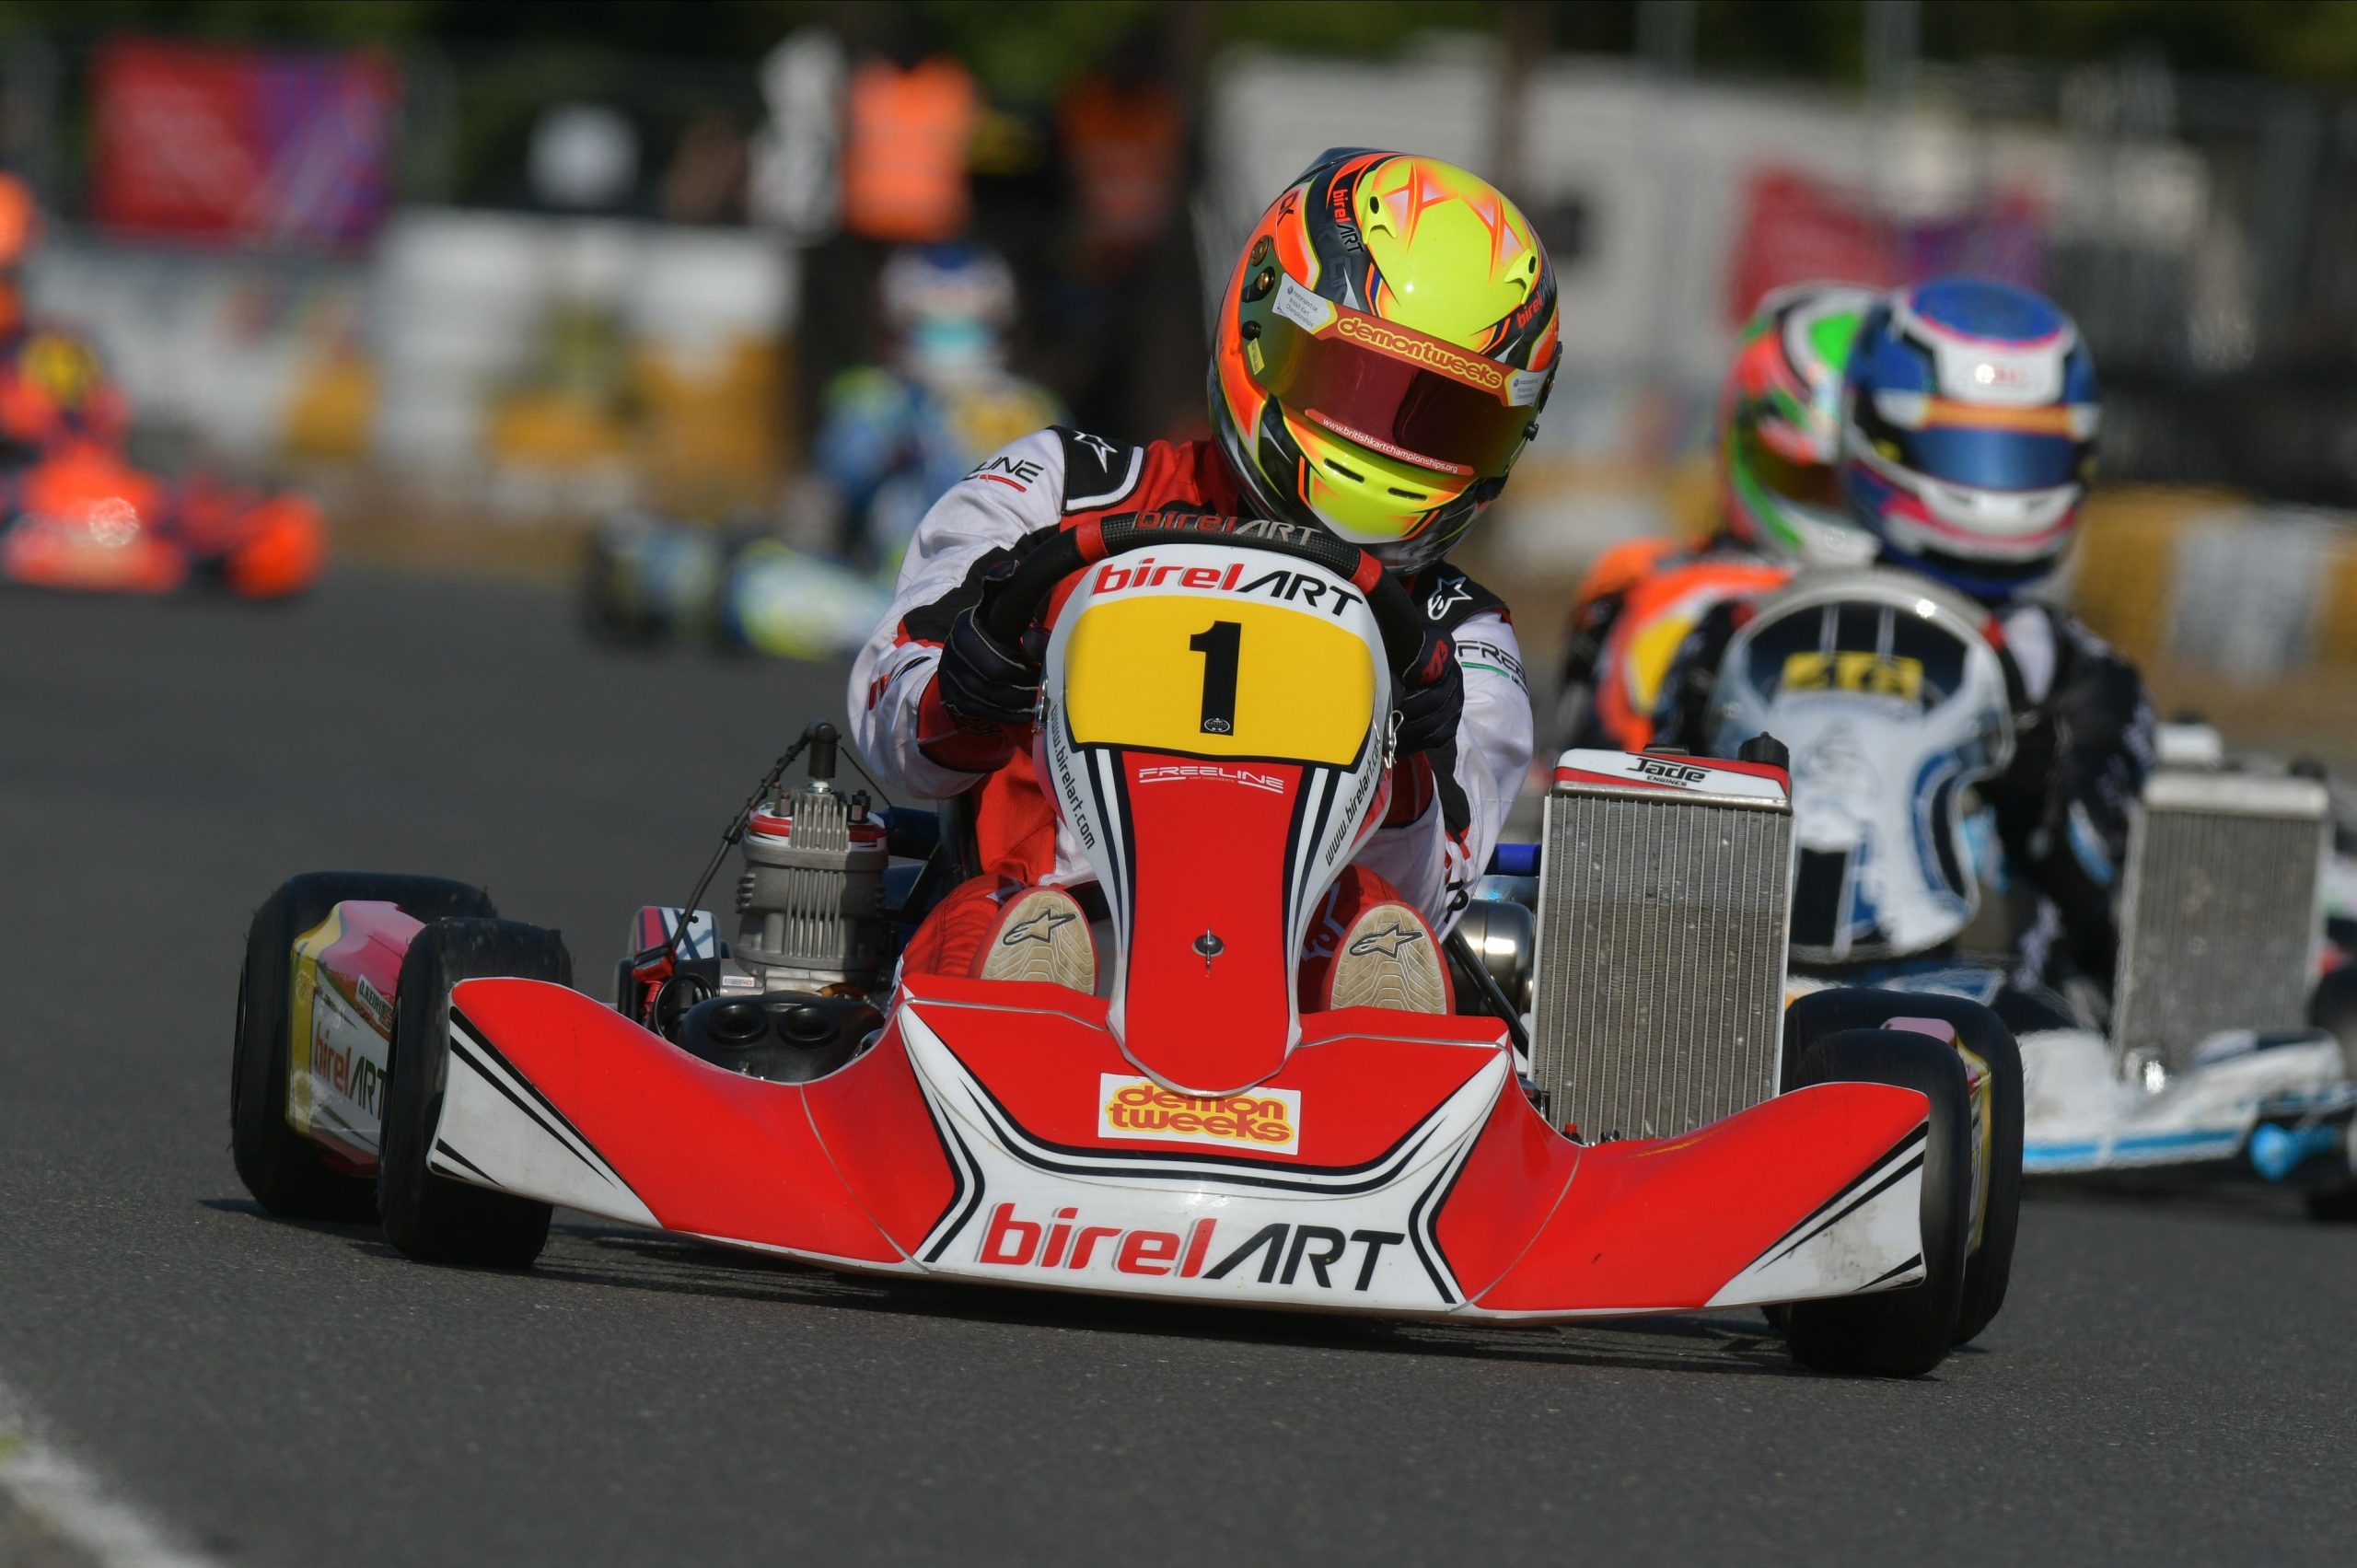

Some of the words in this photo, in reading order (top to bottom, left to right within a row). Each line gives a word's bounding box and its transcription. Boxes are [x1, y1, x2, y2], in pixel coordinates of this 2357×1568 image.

[1332, 188, 1364, 254] birelART
[1338, 317, 1503, 389] demontweeks
[967, 457, 1044, 483] LINE
[1322, 418, 1458, 474] www.britishkartchampionships.org
[1132, 509, 1323, 546] birelART
[1090, 557, 1364, 617] birelART
[1189, 620, 1242, 737] 1
[1051, 703, 1096, 850] www.birelart.com
[1139, 765, 1283, 790] FREELINE
[1626, 757, 1712, 783] Jade
[1646, 775, 1687, 786] ENGINES
[315, 1021, 388, 1121] birelART
[1109, 1103, 1291, 1142] tweeks
[1117, 1085, 1284, 1121] demon
[974, 1202, 1406, 1291] birelART
